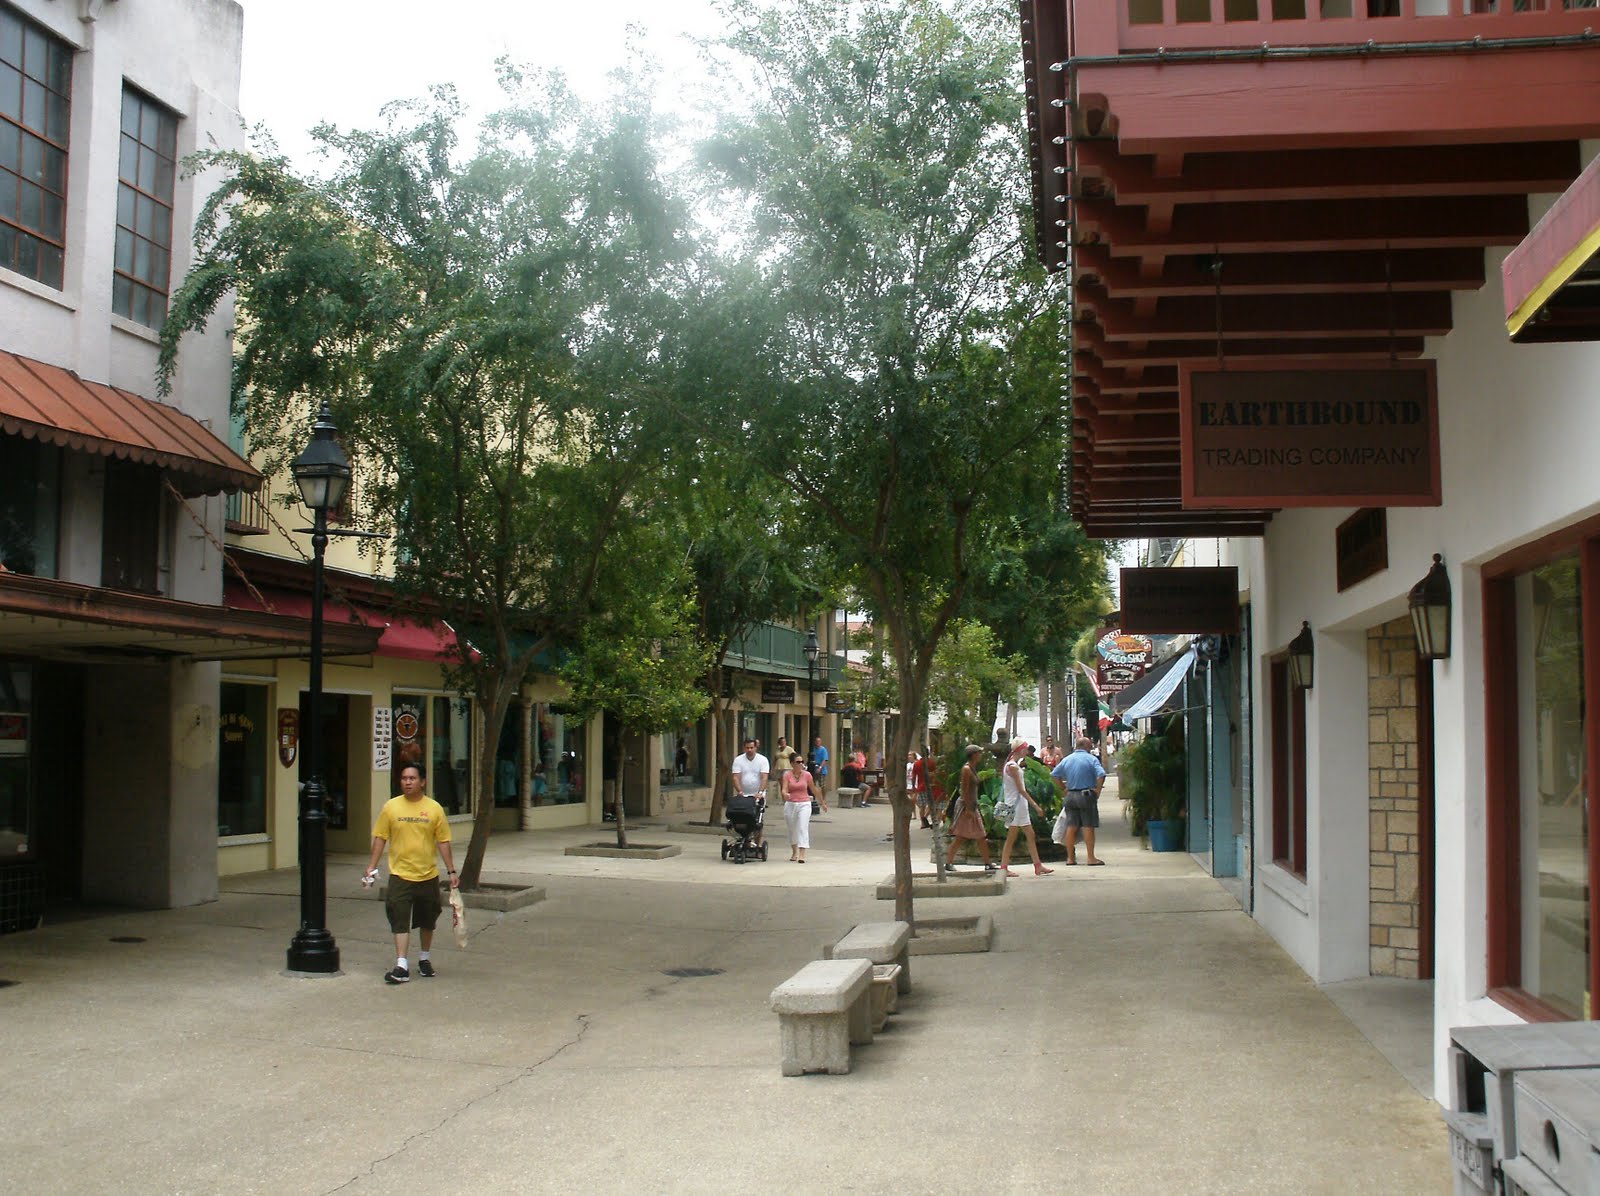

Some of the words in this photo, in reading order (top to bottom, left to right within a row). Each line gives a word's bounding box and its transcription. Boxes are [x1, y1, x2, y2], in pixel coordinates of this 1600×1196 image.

[1199, 401, 1422, 426] EARTHBOUND
[1202, 448, 1303, 466] TRADING
[1309, 447, 1421, 466] COMPANY
[1097, 629, 1128, 649] BURRIT
[1104, 652, 1126, 663] TACO
[1127, 652, 1147, 663] SHOP
